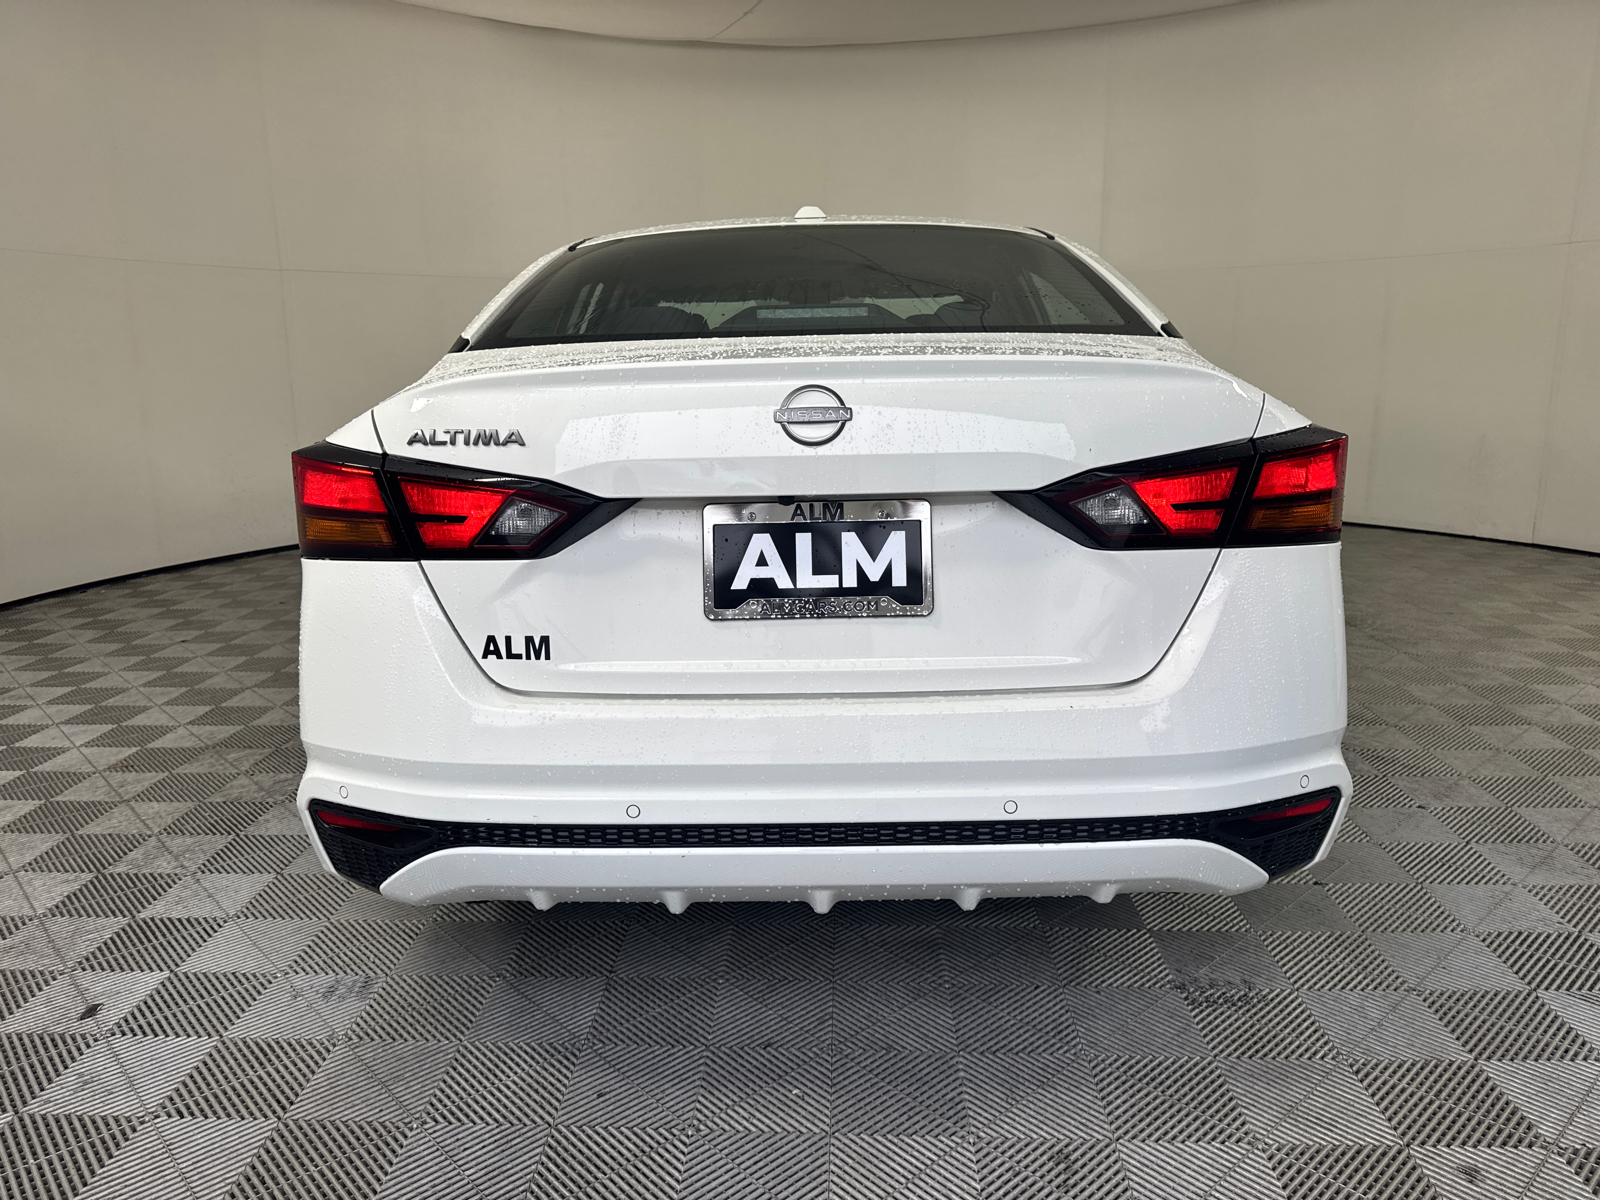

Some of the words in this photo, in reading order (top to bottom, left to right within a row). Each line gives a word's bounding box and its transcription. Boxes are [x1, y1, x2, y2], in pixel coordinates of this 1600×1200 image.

[776, 409, 851, 420] NISSAN
[407, 429, 526, 446] ALTIMA
[791, 502, 844, 522] ALM
[730, 530, 907, 590] ALM
[760, 600, 879, 615] ALMCARS.COM
[481, 634, 551, 660] ALM
